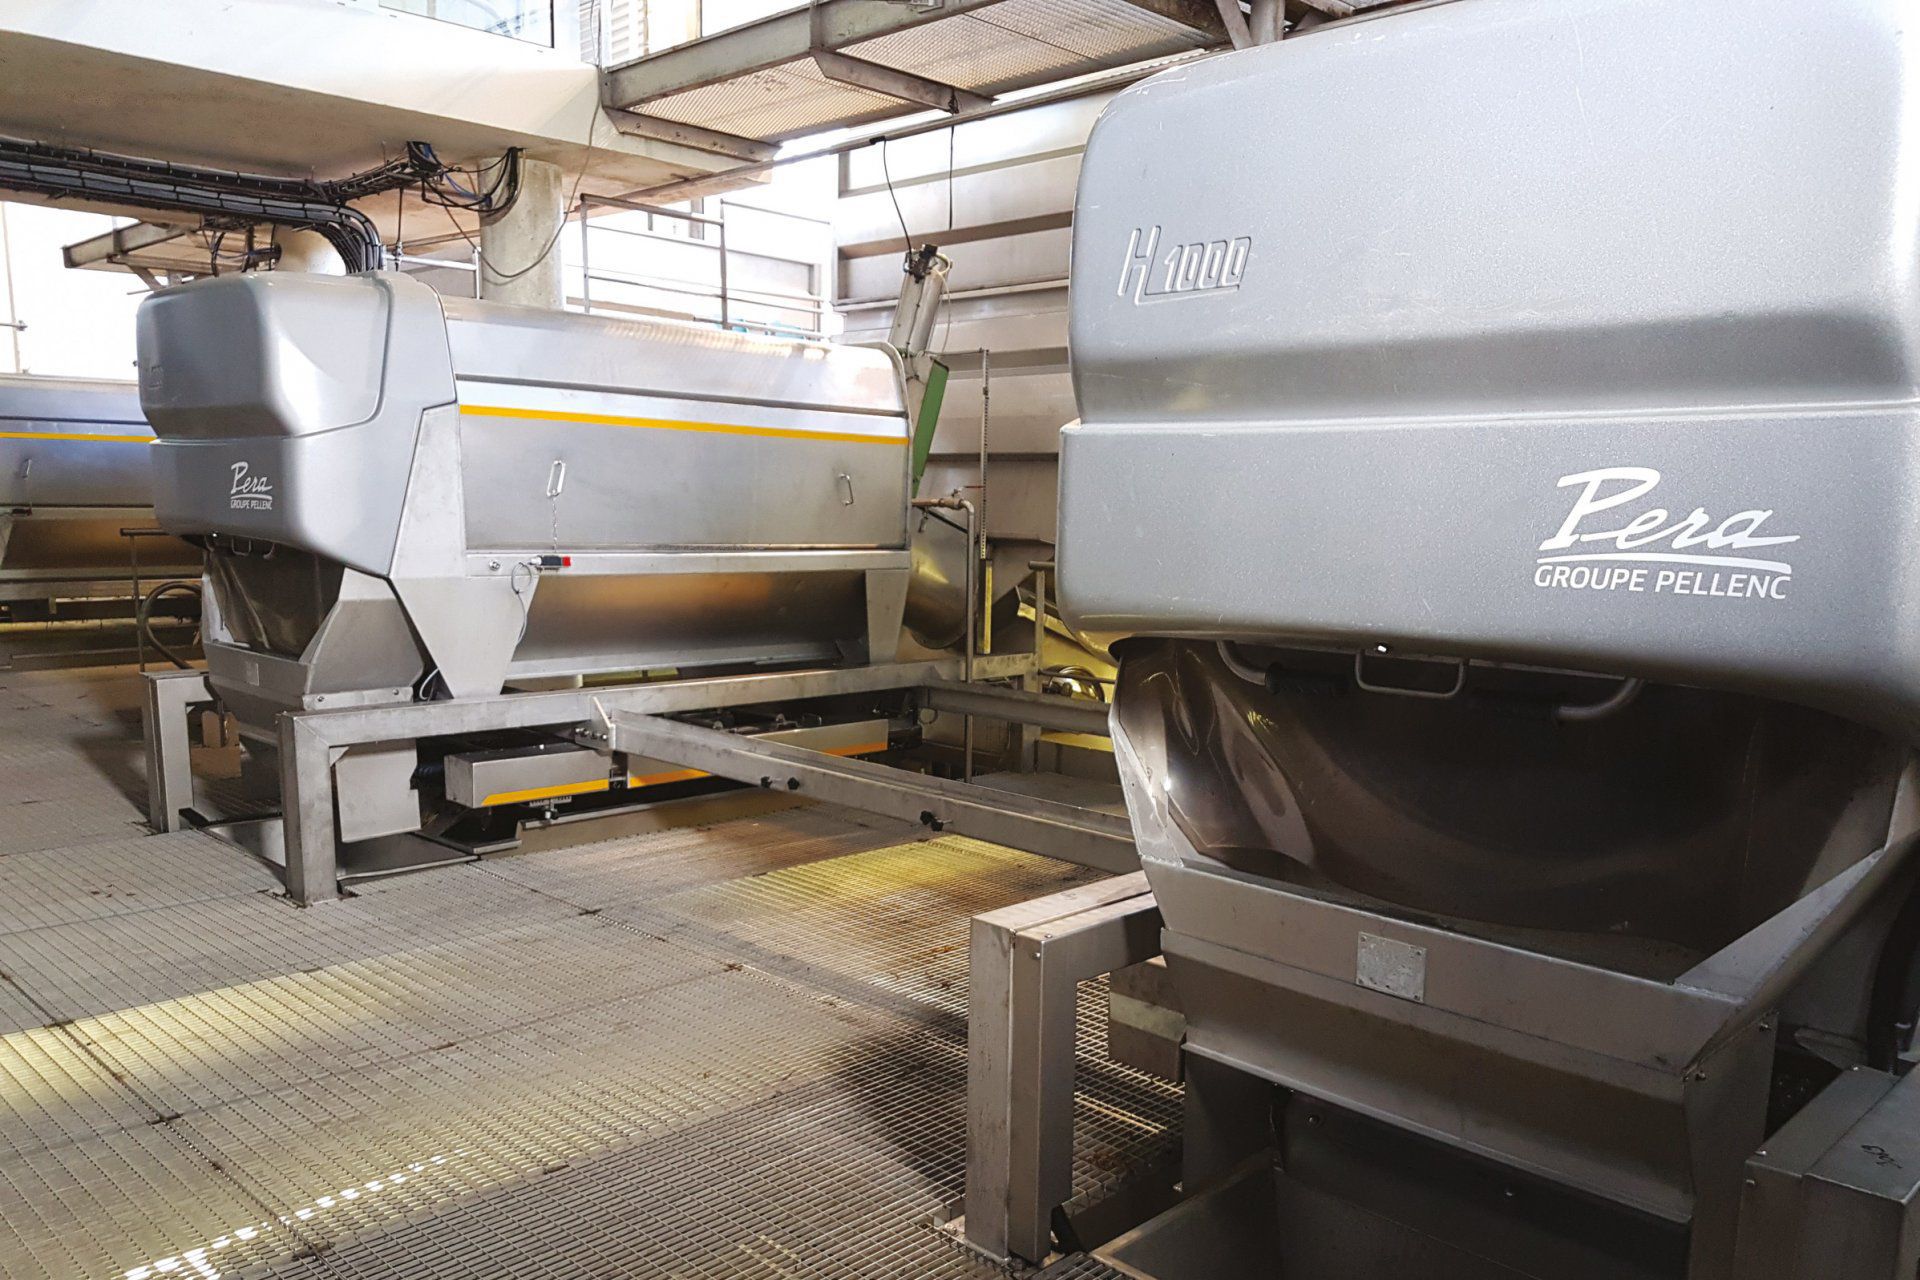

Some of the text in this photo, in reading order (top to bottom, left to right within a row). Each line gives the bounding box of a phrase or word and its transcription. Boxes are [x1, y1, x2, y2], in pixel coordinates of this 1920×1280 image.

[1116, 225, 1252, 306] H 1000
[230, 461, 273, 494] Pera
[230, 499, 250, 509] GROUPE
[1538, 466, 1801, 550] Pera
[1534, 565, 1792, 600] GROUPE PELLENC
